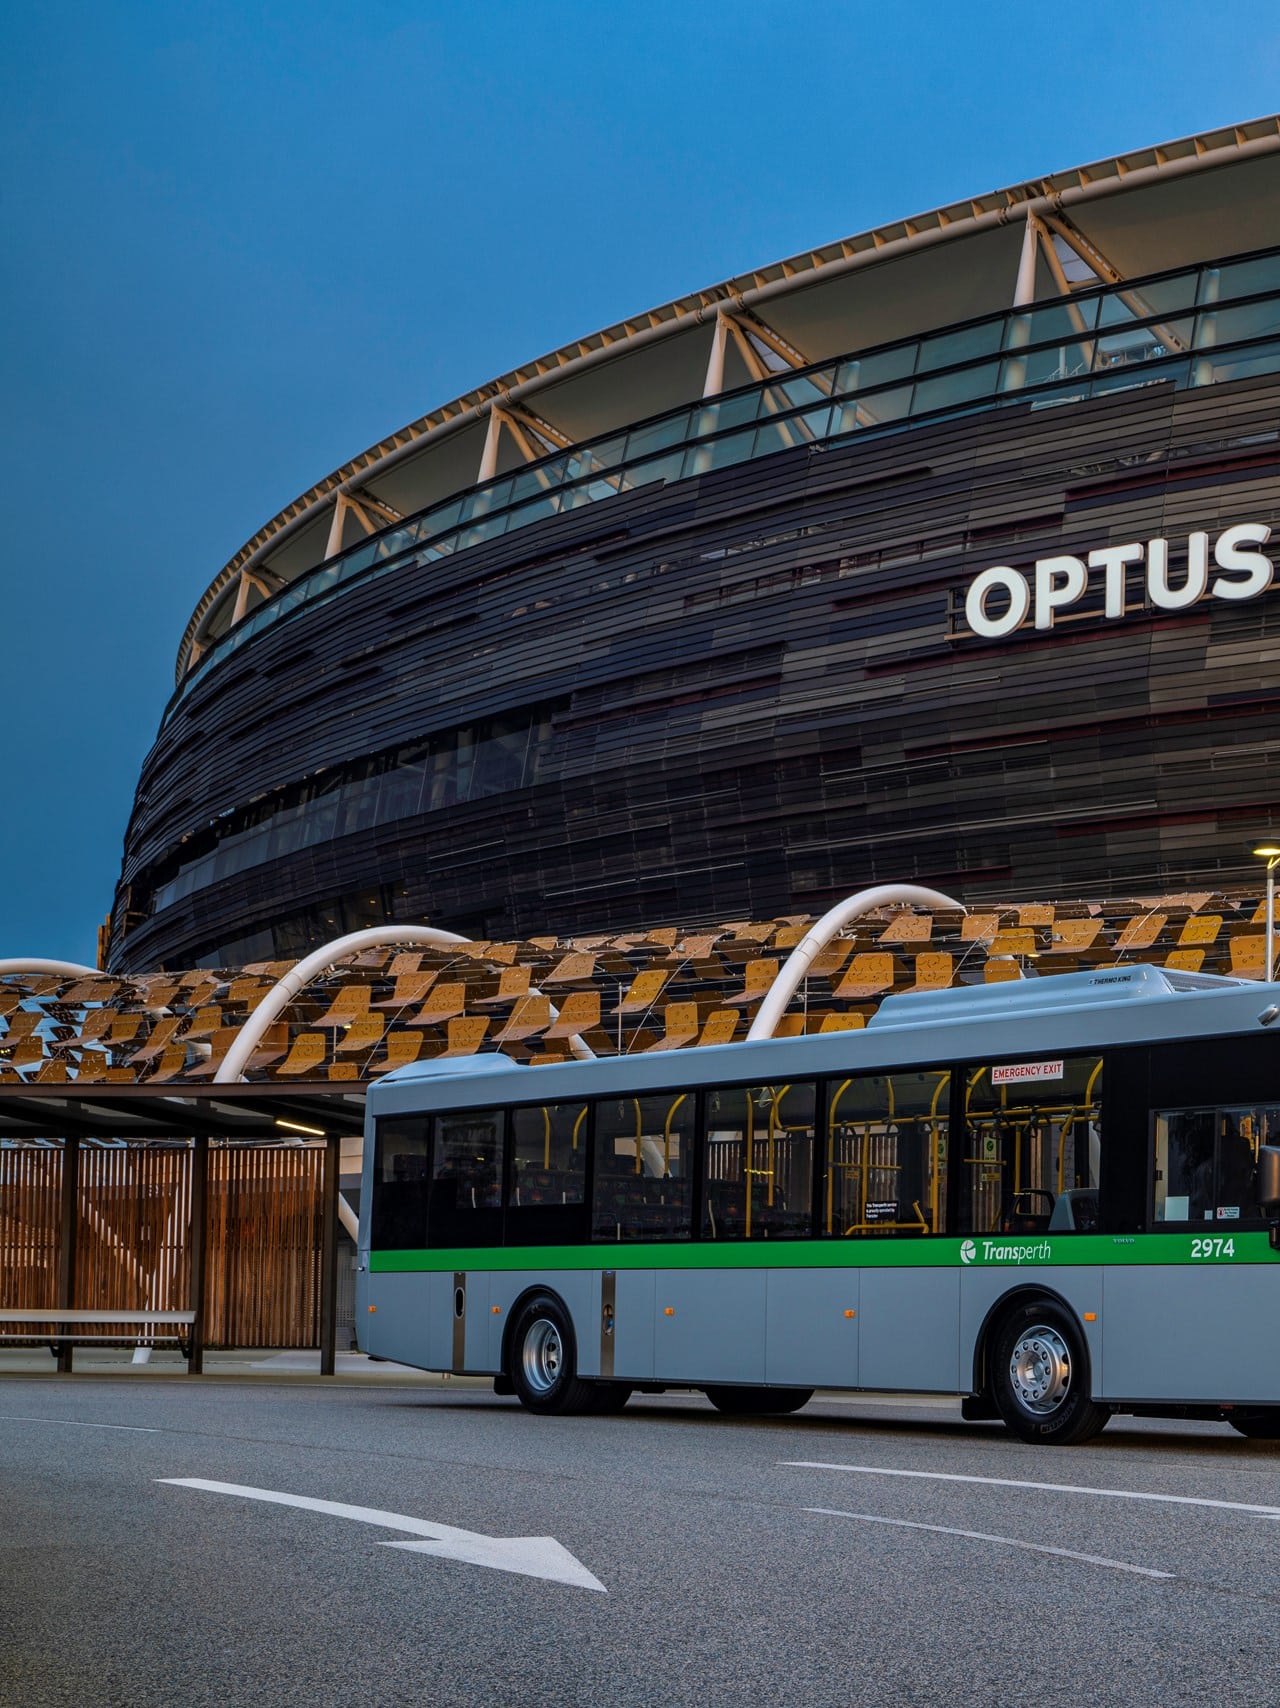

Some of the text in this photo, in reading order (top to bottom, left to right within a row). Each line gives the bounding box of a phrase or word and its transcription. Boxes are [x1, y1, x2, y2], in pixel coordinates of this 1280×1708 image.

[965, 522, 1274, 638] OPTUS
[994, 1064, 1062, 1079] EMERGENCY EXIT
[982, 1241, 1051, 1264] Transperth
[1190, 1238, 1235, 1258] 2974
